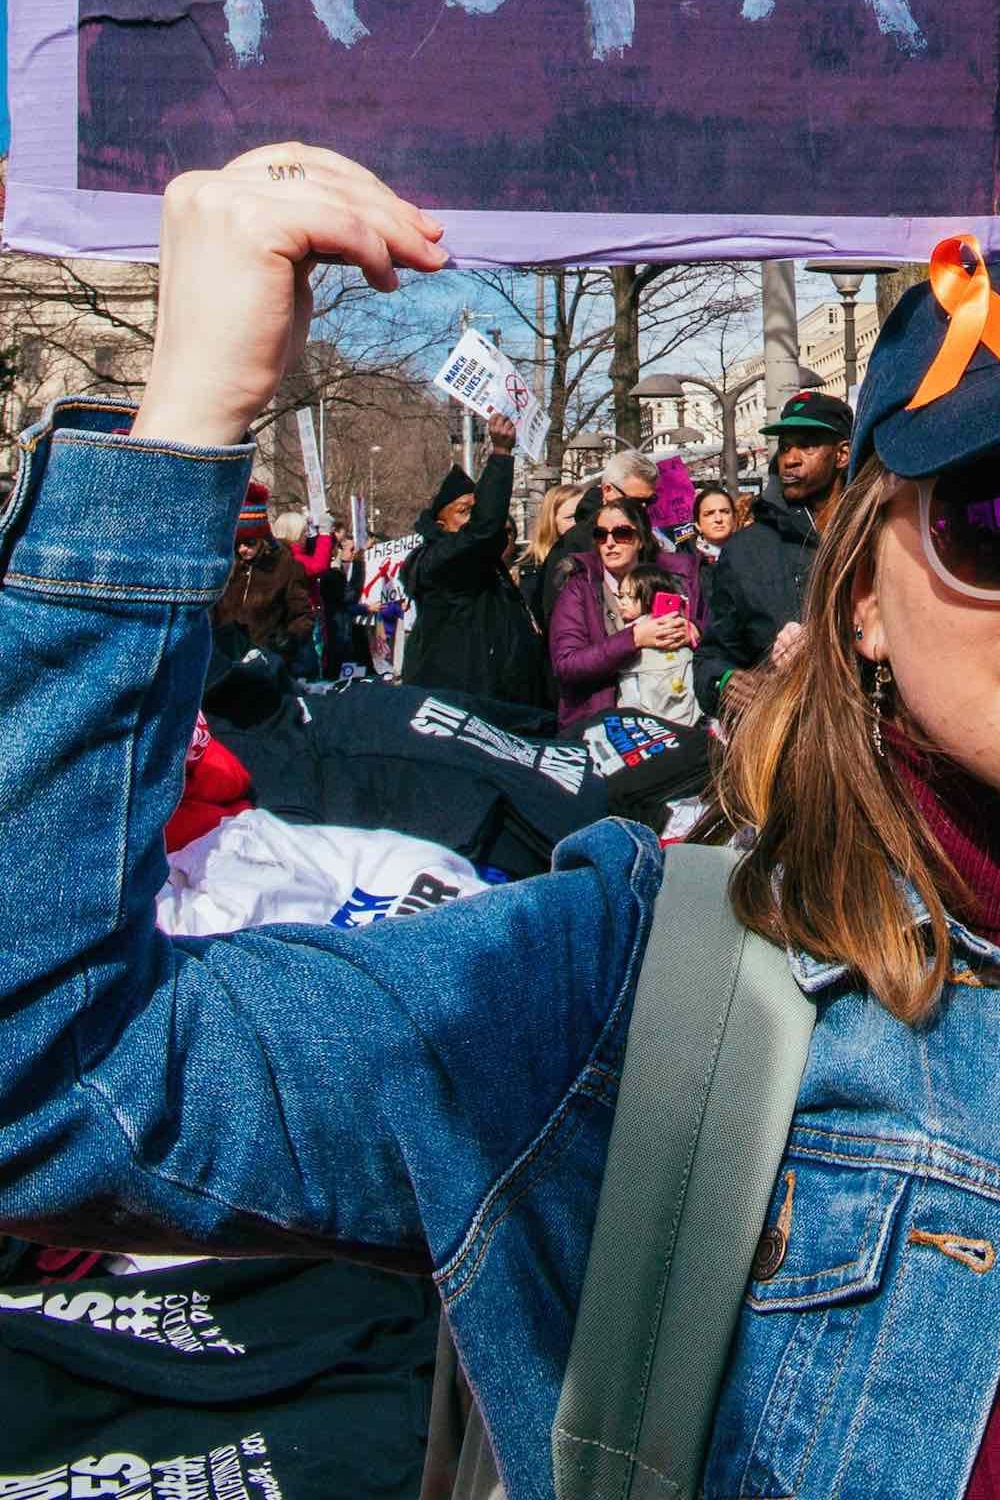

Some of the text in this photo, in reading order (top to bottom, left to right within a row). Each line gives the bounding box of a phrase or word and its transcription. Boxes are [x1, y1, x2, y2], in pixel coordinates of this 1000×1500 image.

[443, 355, 469, 385] MARCH
[453, 358, 480, 391] FOR OUR
[462, 375, 482, 398] LIVES
